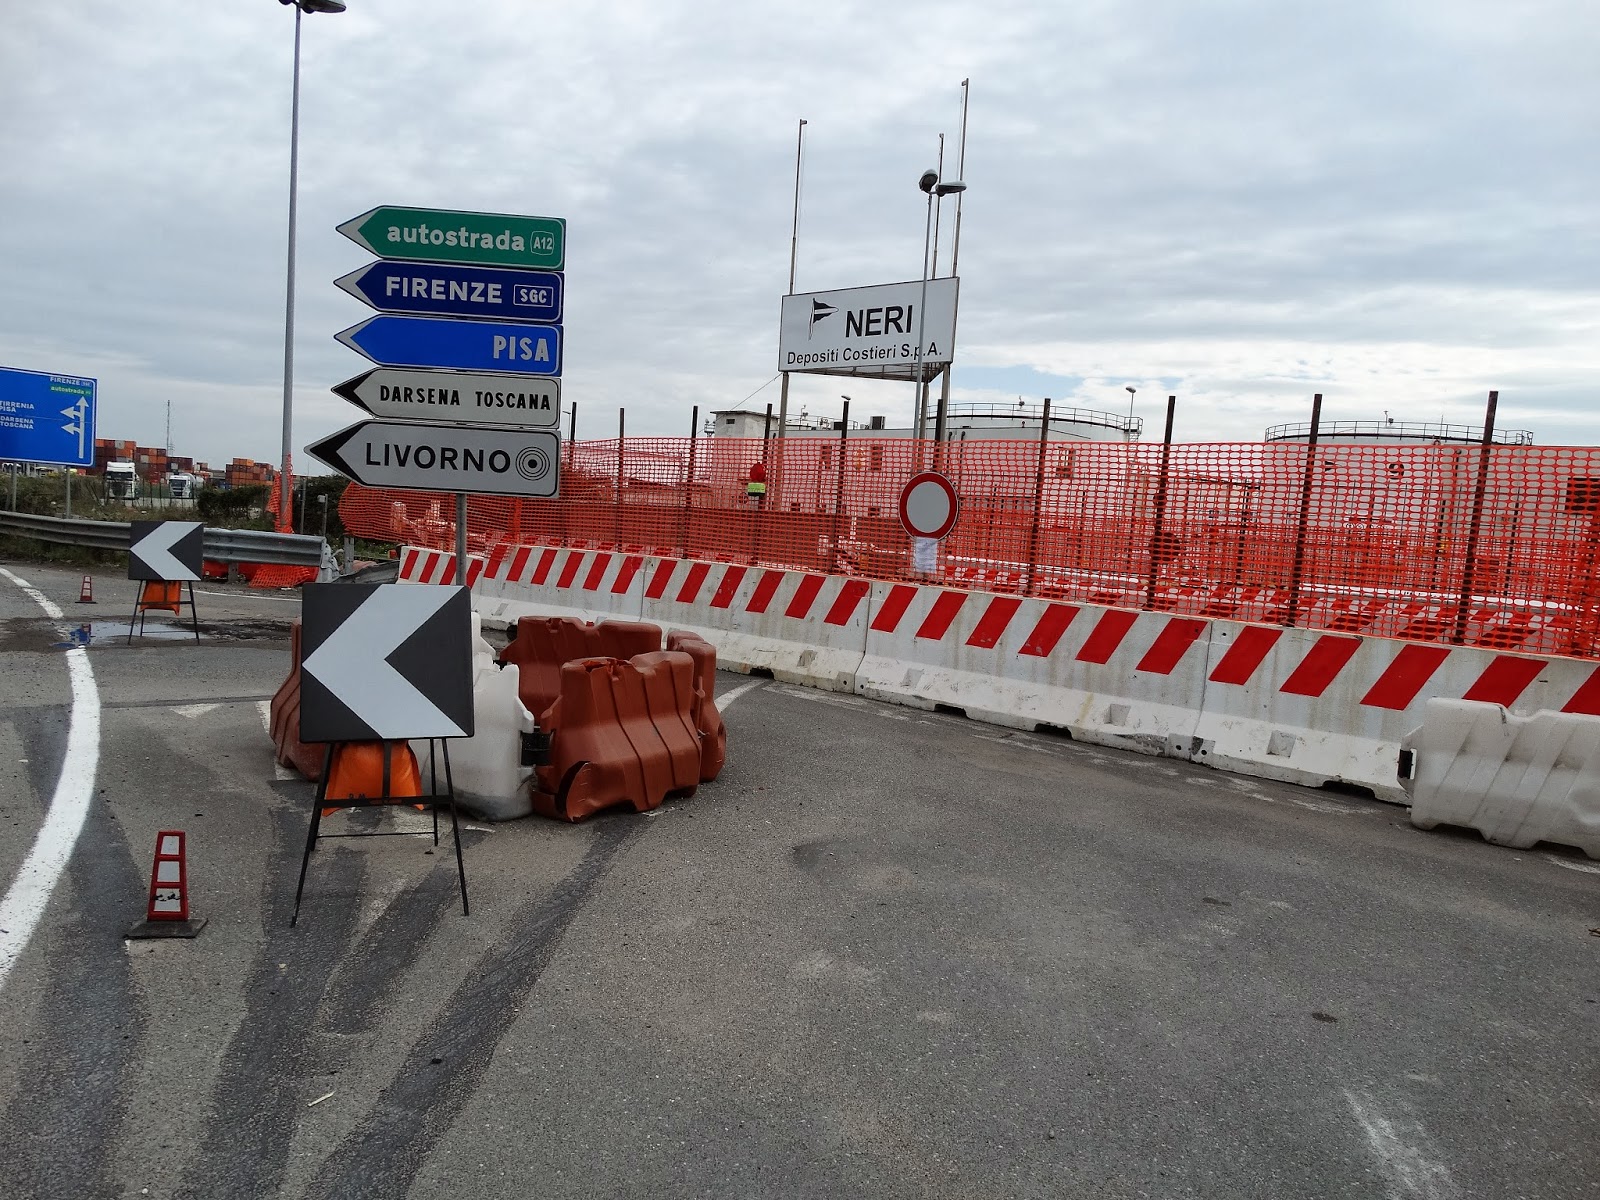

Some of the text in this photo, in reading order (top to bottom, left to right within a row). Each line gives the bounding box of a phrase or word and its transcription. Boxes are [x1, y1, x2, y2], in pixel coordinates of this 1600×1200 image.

[387, 224, 553, 251] autostrada A12
[386, 276, 547, 303] FIRENZE SGC
[845, 304, 913, 338] NERI
[493, 335, 550, 361] PISA
[787, 341, 942, 366] Depositi Costieri S.p.A.
[50, 376, 80, 385] FIRENZE
[50, 386, 84, 395] autostrada
[380, 385, 551, 410] DARSENA TOSCANA
[0, 416, 34, 424] DARSENA
[0, 421, 34, 430] TOSCANA
[366, 442, 511, 473] LIVORNO
